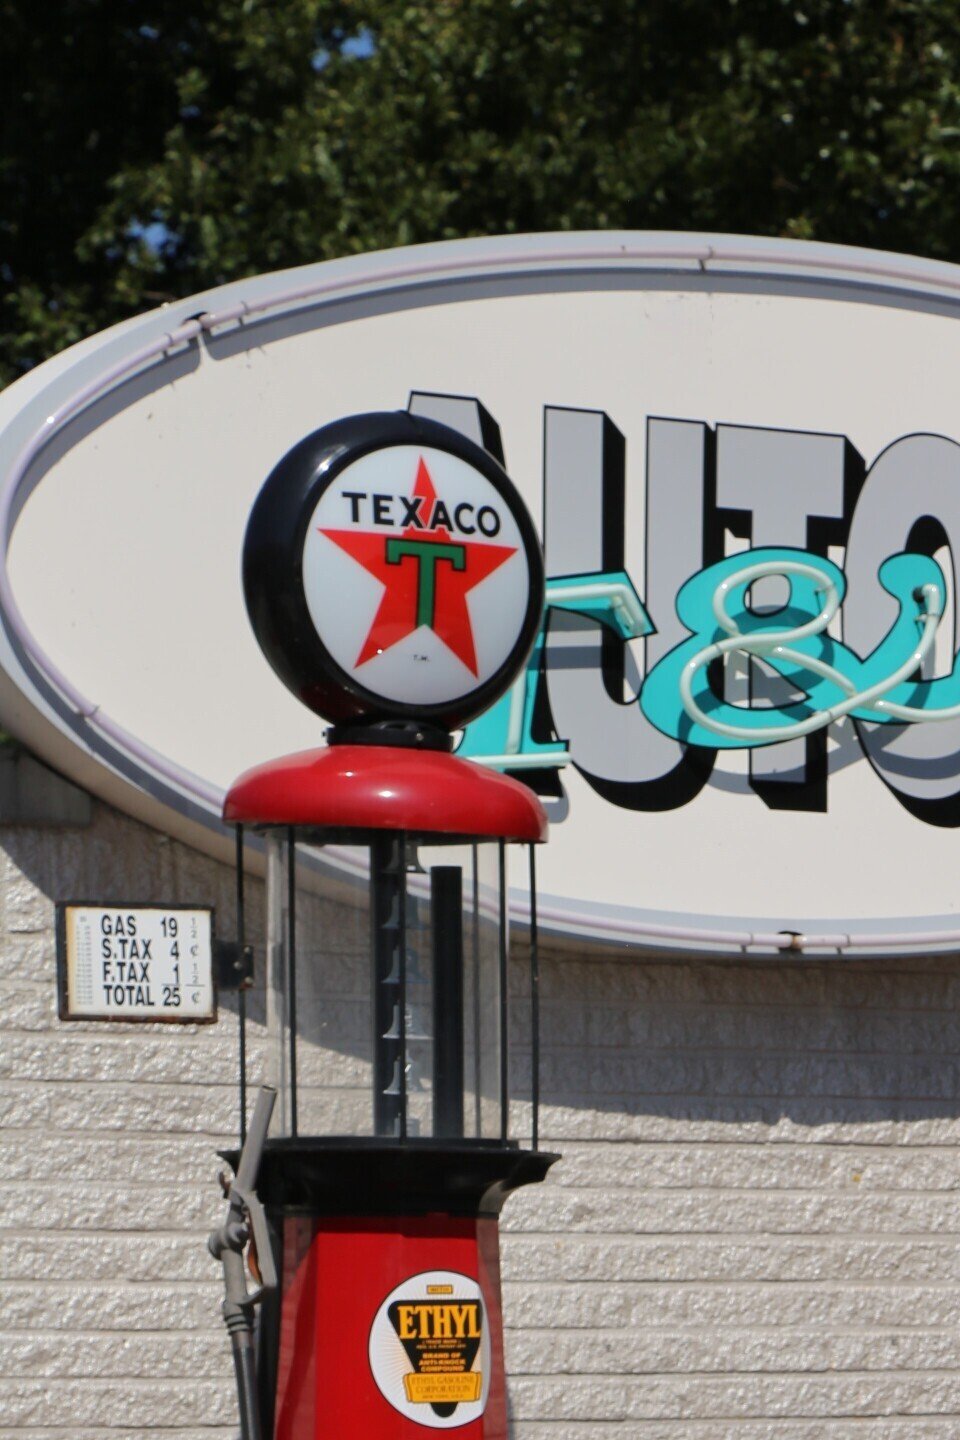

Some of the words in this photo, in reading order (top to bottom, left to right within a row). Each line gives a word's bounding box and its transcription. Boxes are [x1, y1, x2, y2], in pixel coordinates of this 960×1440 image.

[342, 491, 501, 538] TEXACO
[385, 537, 466, 630] T
[101, 915, 136, 936] GAS
[161, 917, 178, 938] 19
[102, 938, 152, 960] S.TAX
[170, 941, 180, 960] 4
[103, 961, 151, 983] F.TAX
[173, 964, 180, 984] 1
[103, 984, 154, 1006] TOTAL
[163, 987, 181, 1006] 25
[397, 1304, 481, 1339] ETHYL
